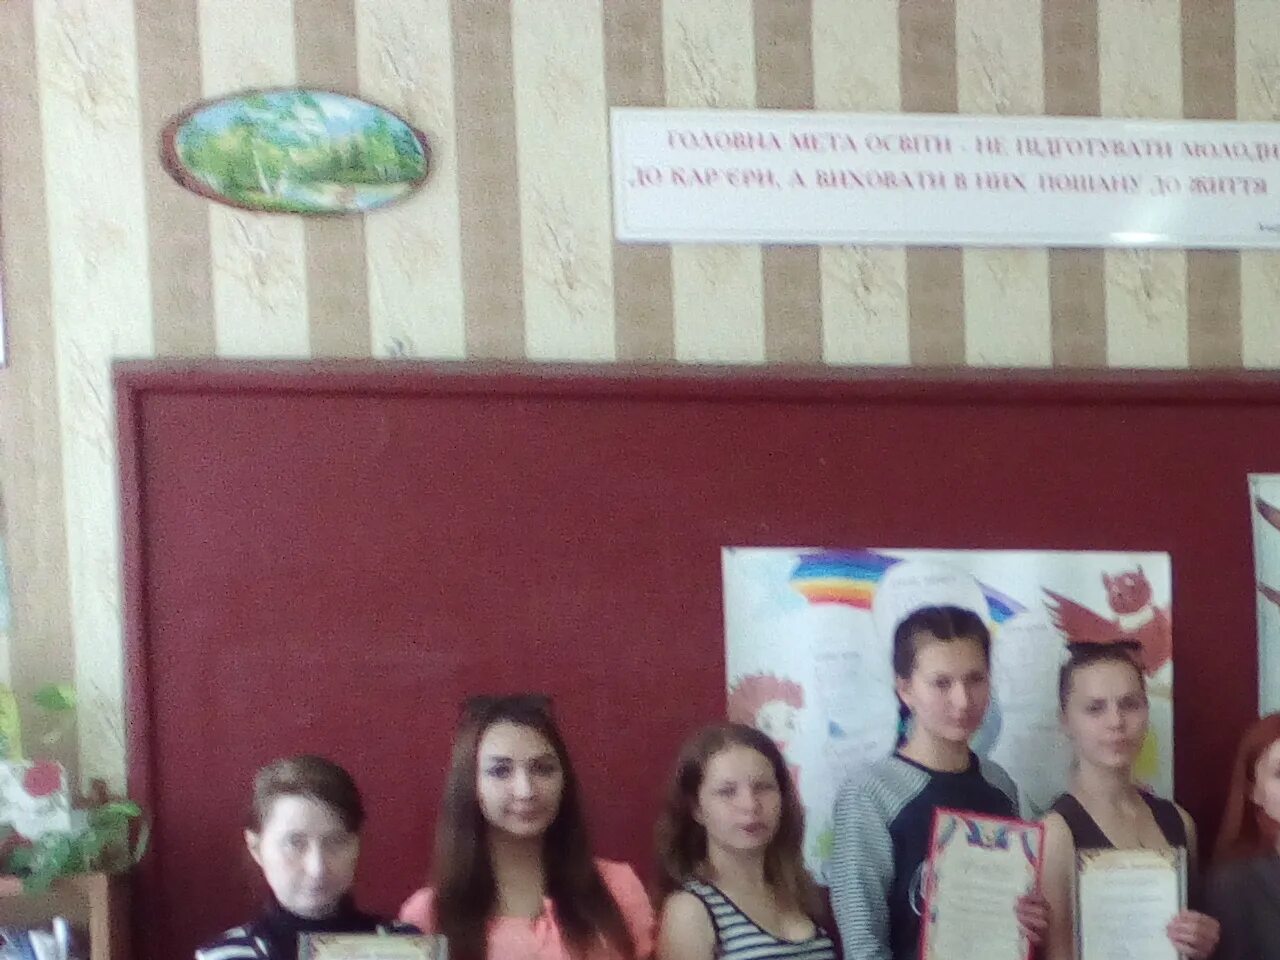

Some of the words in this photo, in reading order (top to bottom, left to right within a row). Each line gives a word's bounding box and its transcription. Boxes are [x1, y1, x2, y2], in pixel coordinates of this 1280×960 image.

[667, 129, 782, 151] ГОЛОВНА
[790, 132, 858, 153] МЕТА
[975, 136, 1009, 156] НЕ
[815, 169, 947, 190] ВИХОВАТИ
[1189, 175, 1268, 196] ЖИТТЯ
